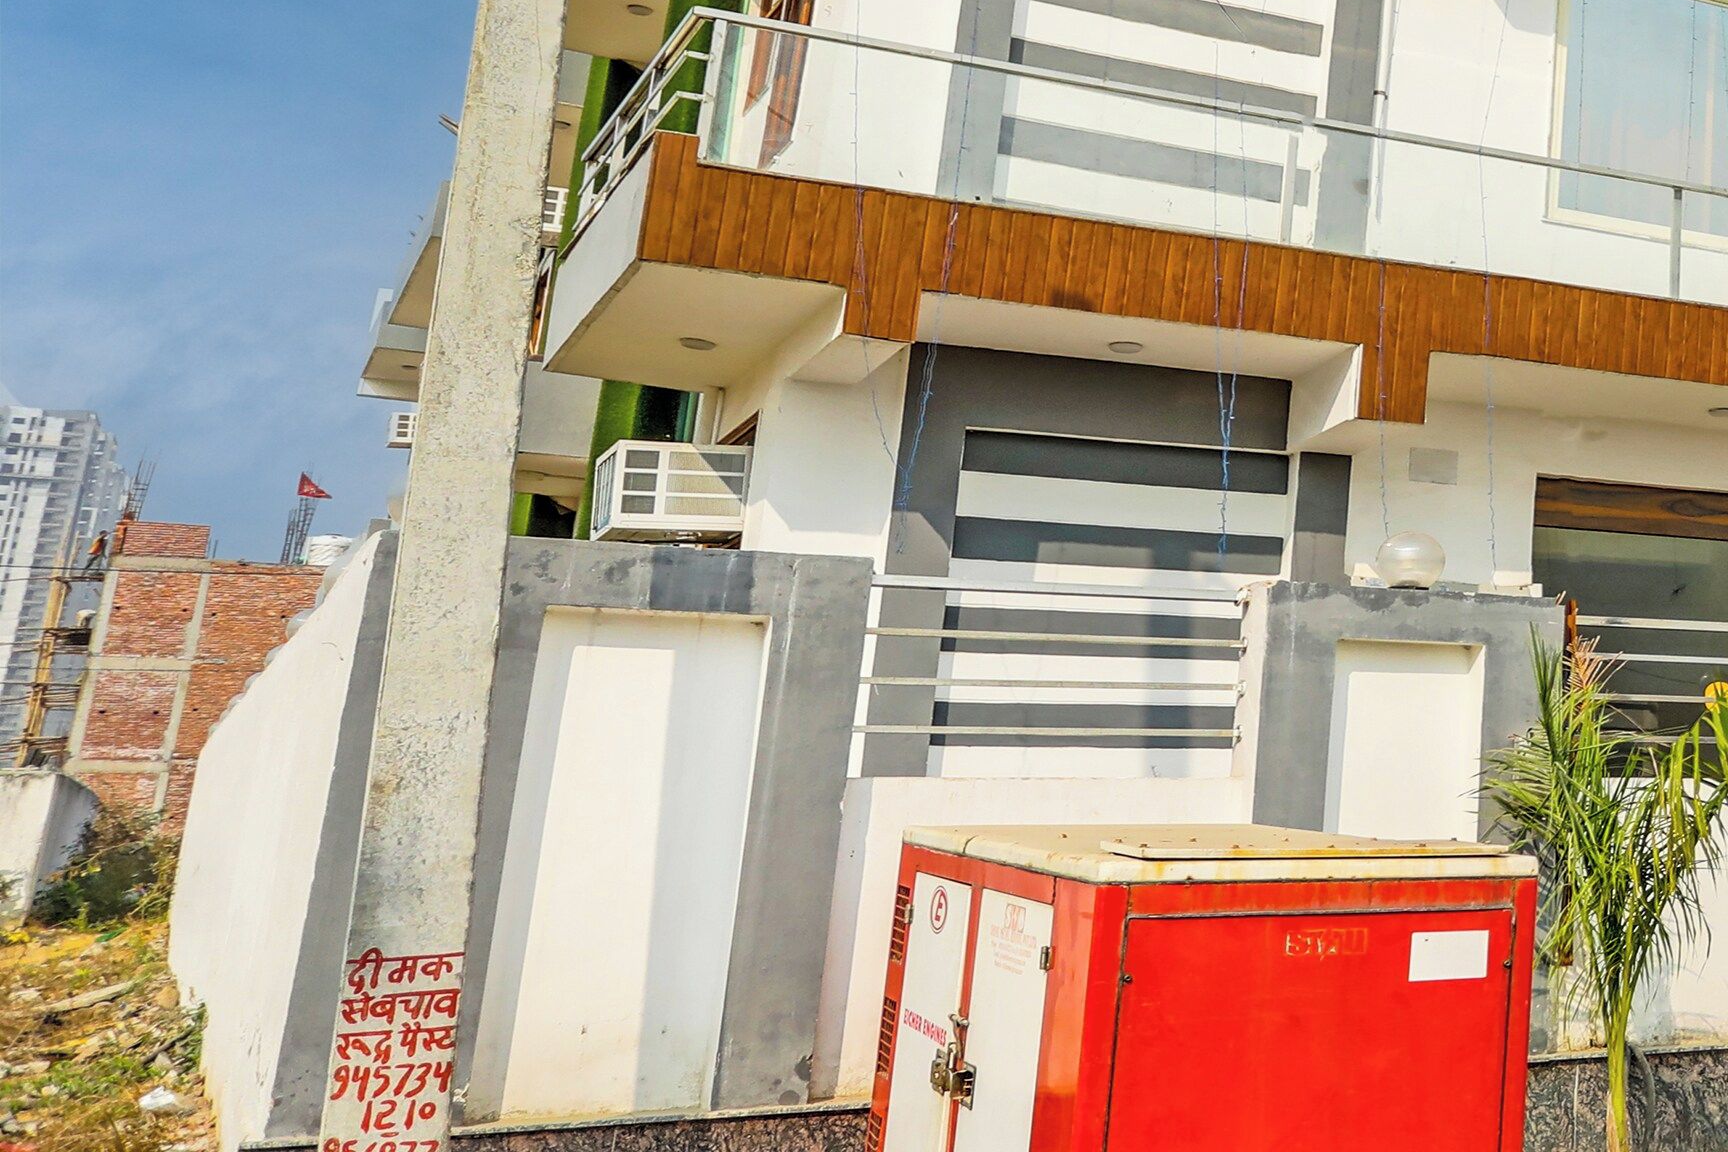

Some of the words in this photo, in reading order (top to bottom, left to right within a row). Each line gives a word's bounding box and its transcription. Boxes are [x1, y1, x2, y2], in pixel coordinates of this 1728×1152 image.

[346, 947, 465, 994] दीमक
[330, 1061, 453, 1102] 945734
[360, 1099, 437, 1134] 1210
